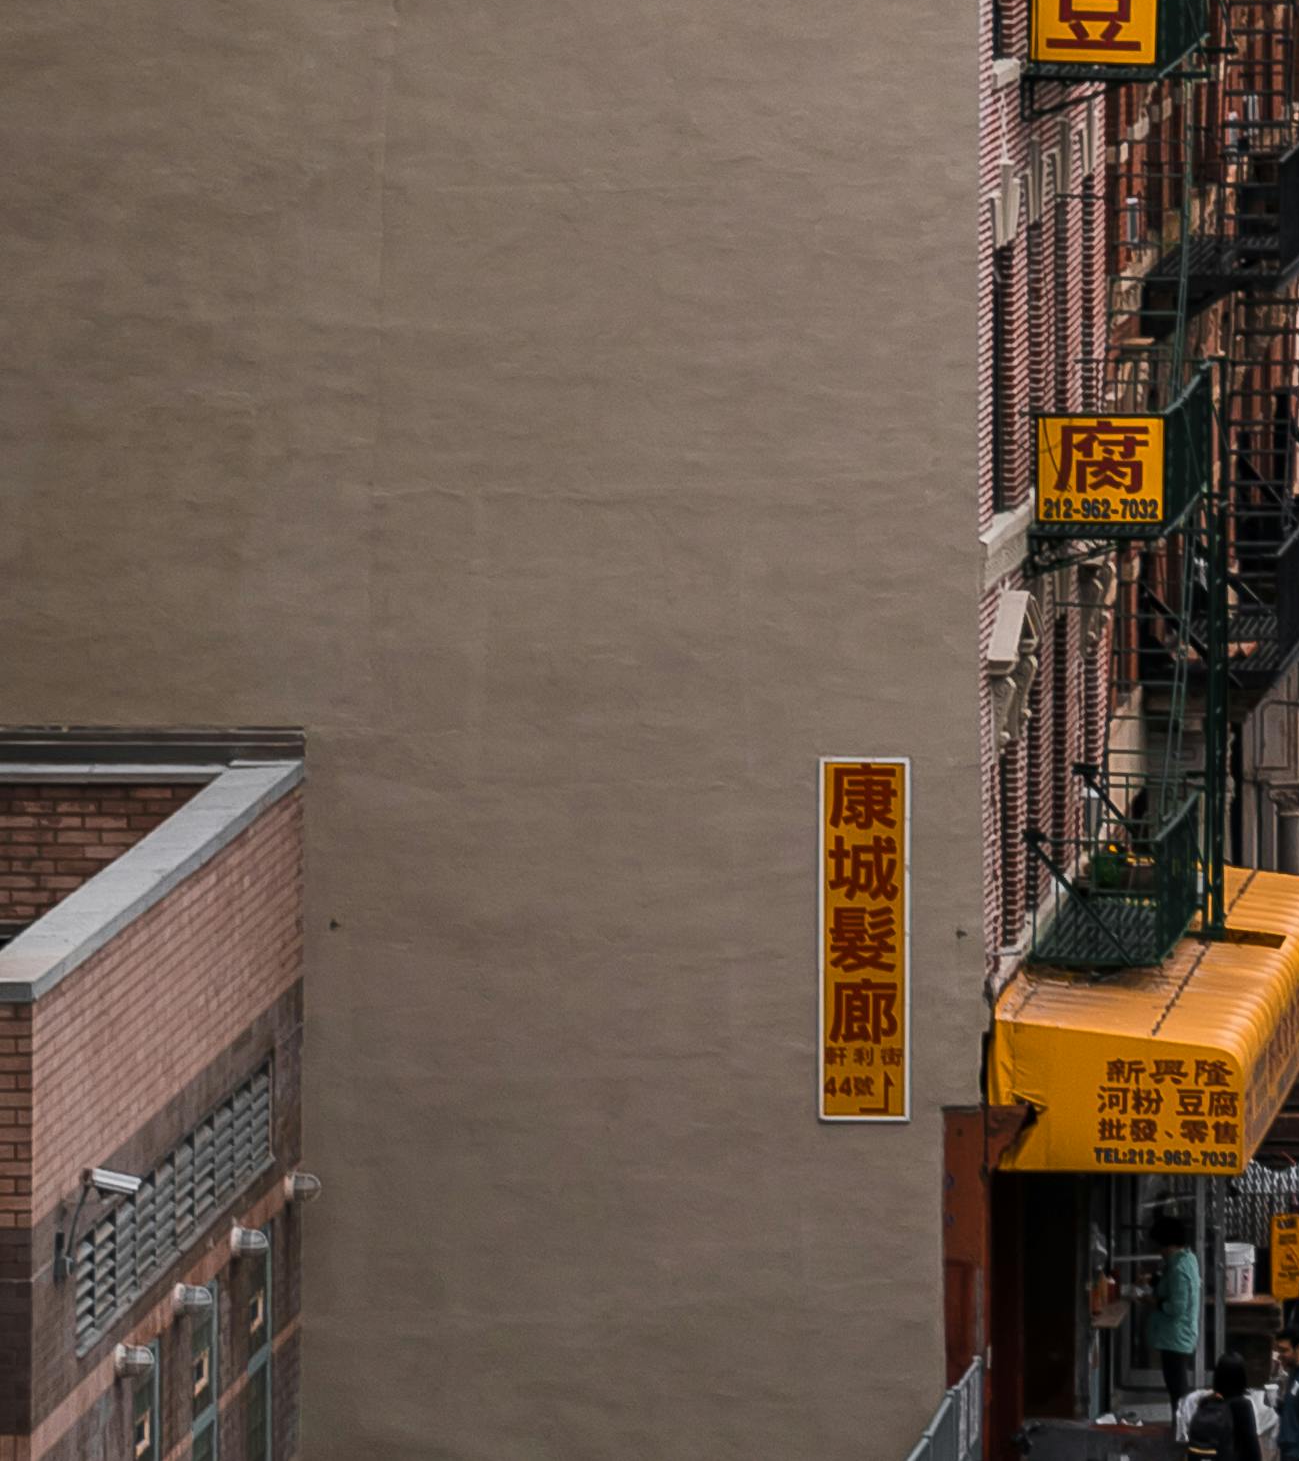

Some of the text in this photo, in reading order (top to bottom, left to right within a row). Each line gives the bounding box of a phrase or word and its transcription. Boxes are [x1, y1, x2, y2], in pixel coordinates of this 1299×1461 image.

[1052, 420, 1149, 494] 腐
[1043, 497, 1159, 520] 212-962-7032
[828, 762, 899, 1045] 康城髮廊
[1097, 1085, 1240, 1118] 河粉 豆腐
